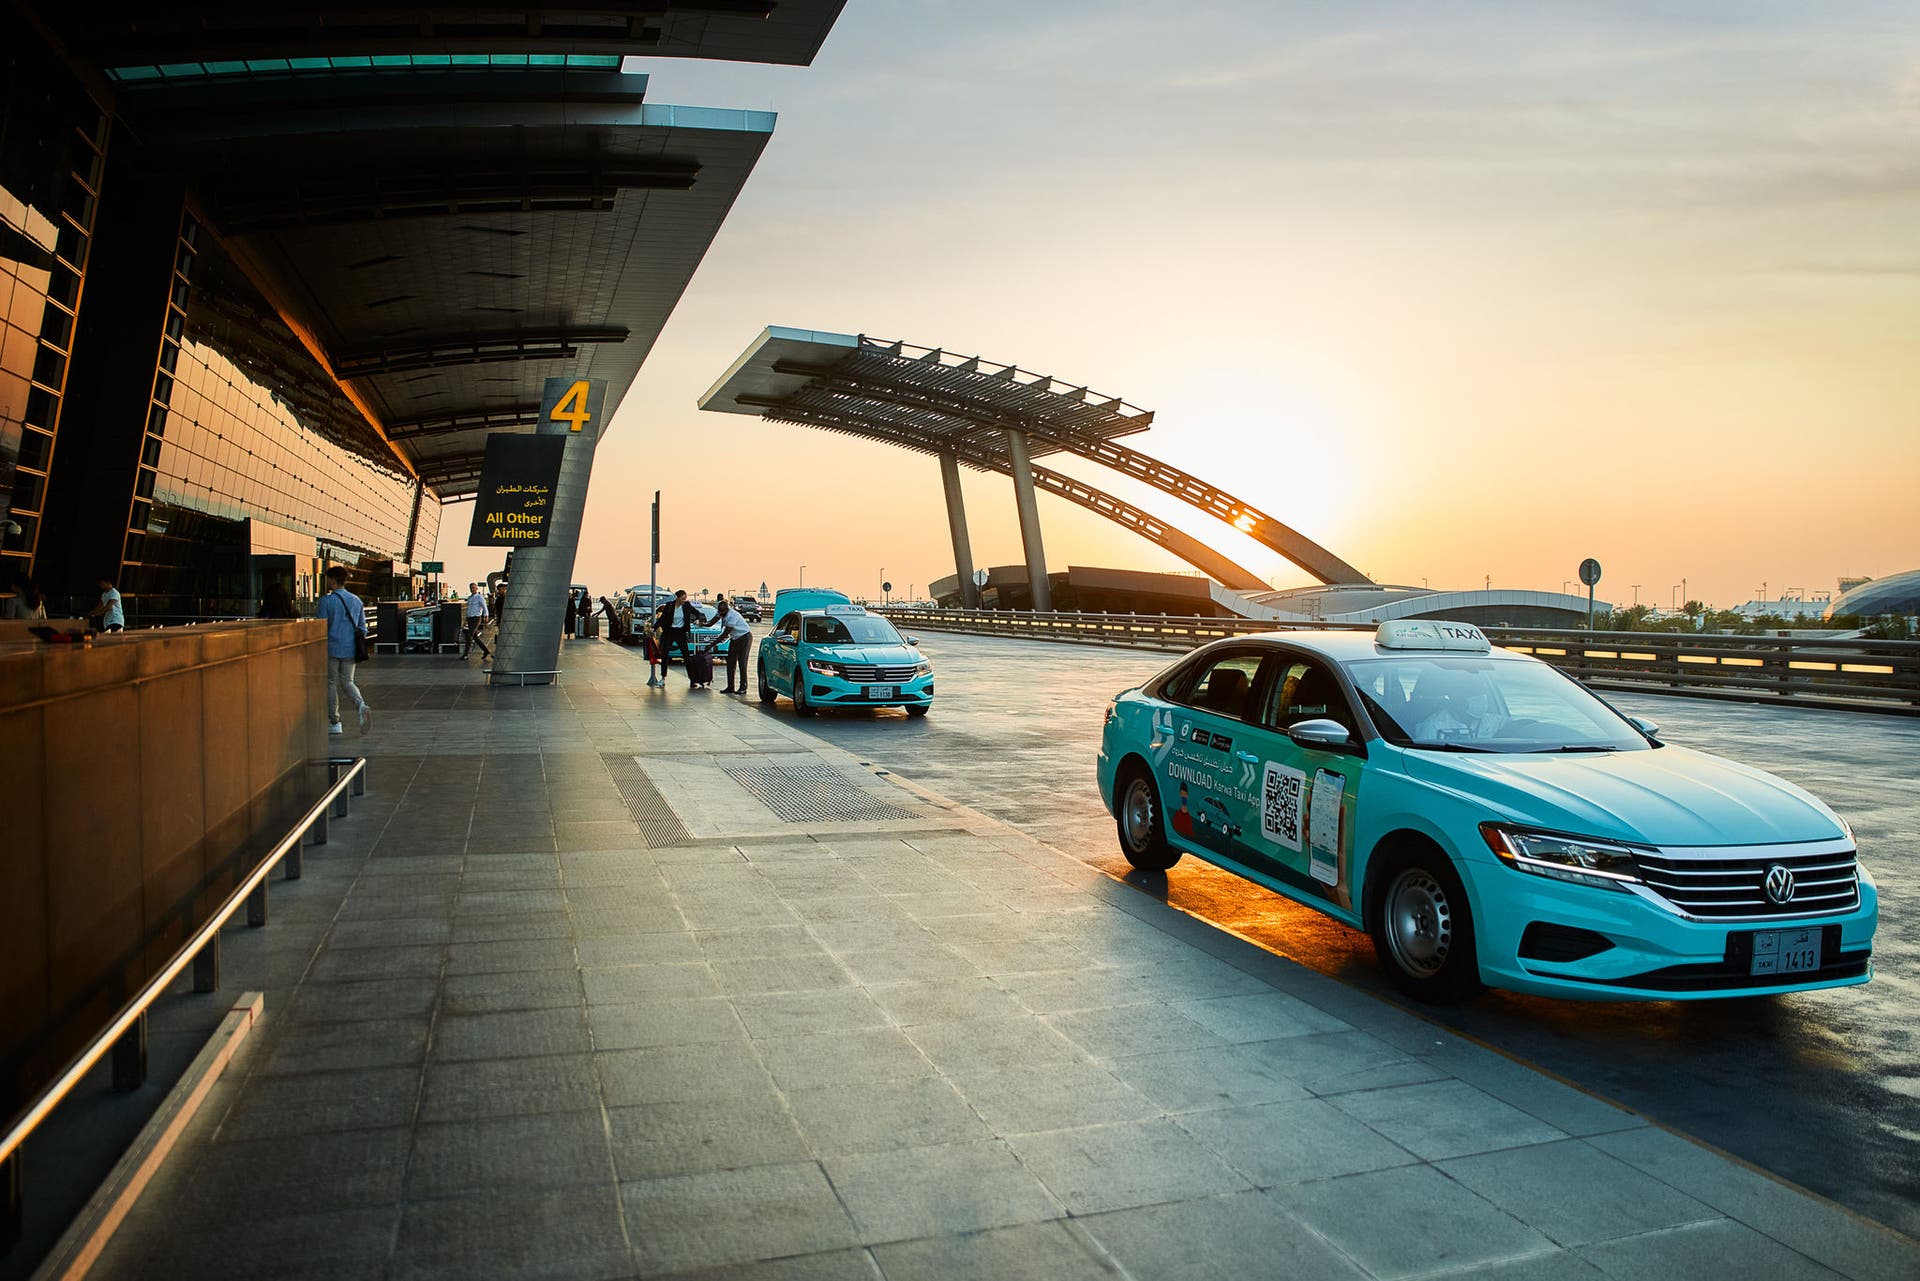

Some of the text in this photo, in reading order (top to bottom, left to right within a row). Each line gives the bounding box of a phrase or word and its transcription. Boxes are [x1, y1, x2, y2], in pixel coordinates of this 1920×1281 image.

[550, 380, 591, 431] 4
[496, 485, 549, 494] شركات الطيران
[524, 496, 546, 507] الأخرى
[486, 512, 544, 524] All Other
[492, 527, 540, 539] Airlines
[1442, 627, 1483, 641] TAXI
[1168, 762, 1260, 808] DOWNLOAD Karwa Taxi App
[1785, 950, 1815, 969] 1413
